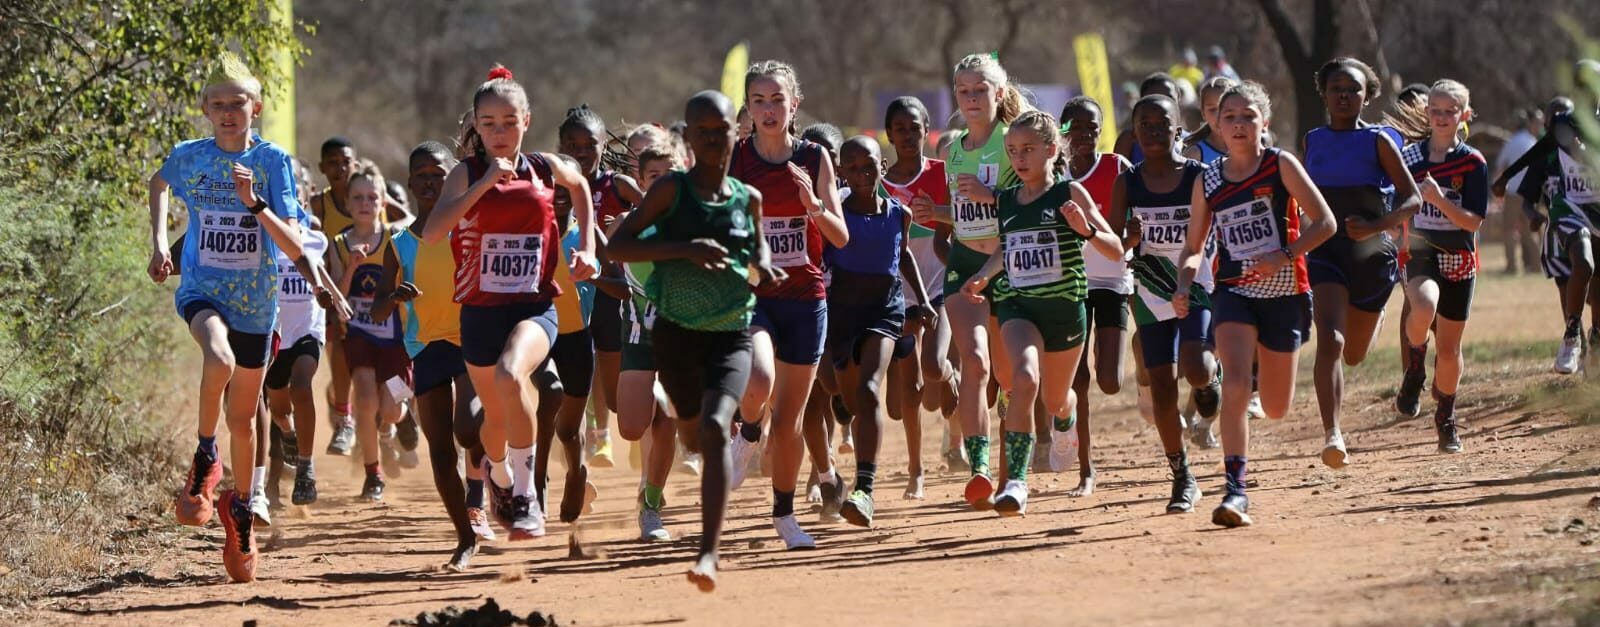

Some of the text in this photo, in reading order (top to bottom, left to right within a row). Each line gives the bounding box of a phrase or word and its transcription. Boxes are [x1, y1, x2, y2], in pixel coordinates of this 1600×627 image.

[220, 217, 235, 225] 2025
[770, 221, 785, 229] 2025
[504, 240, 519, 248] 2025
